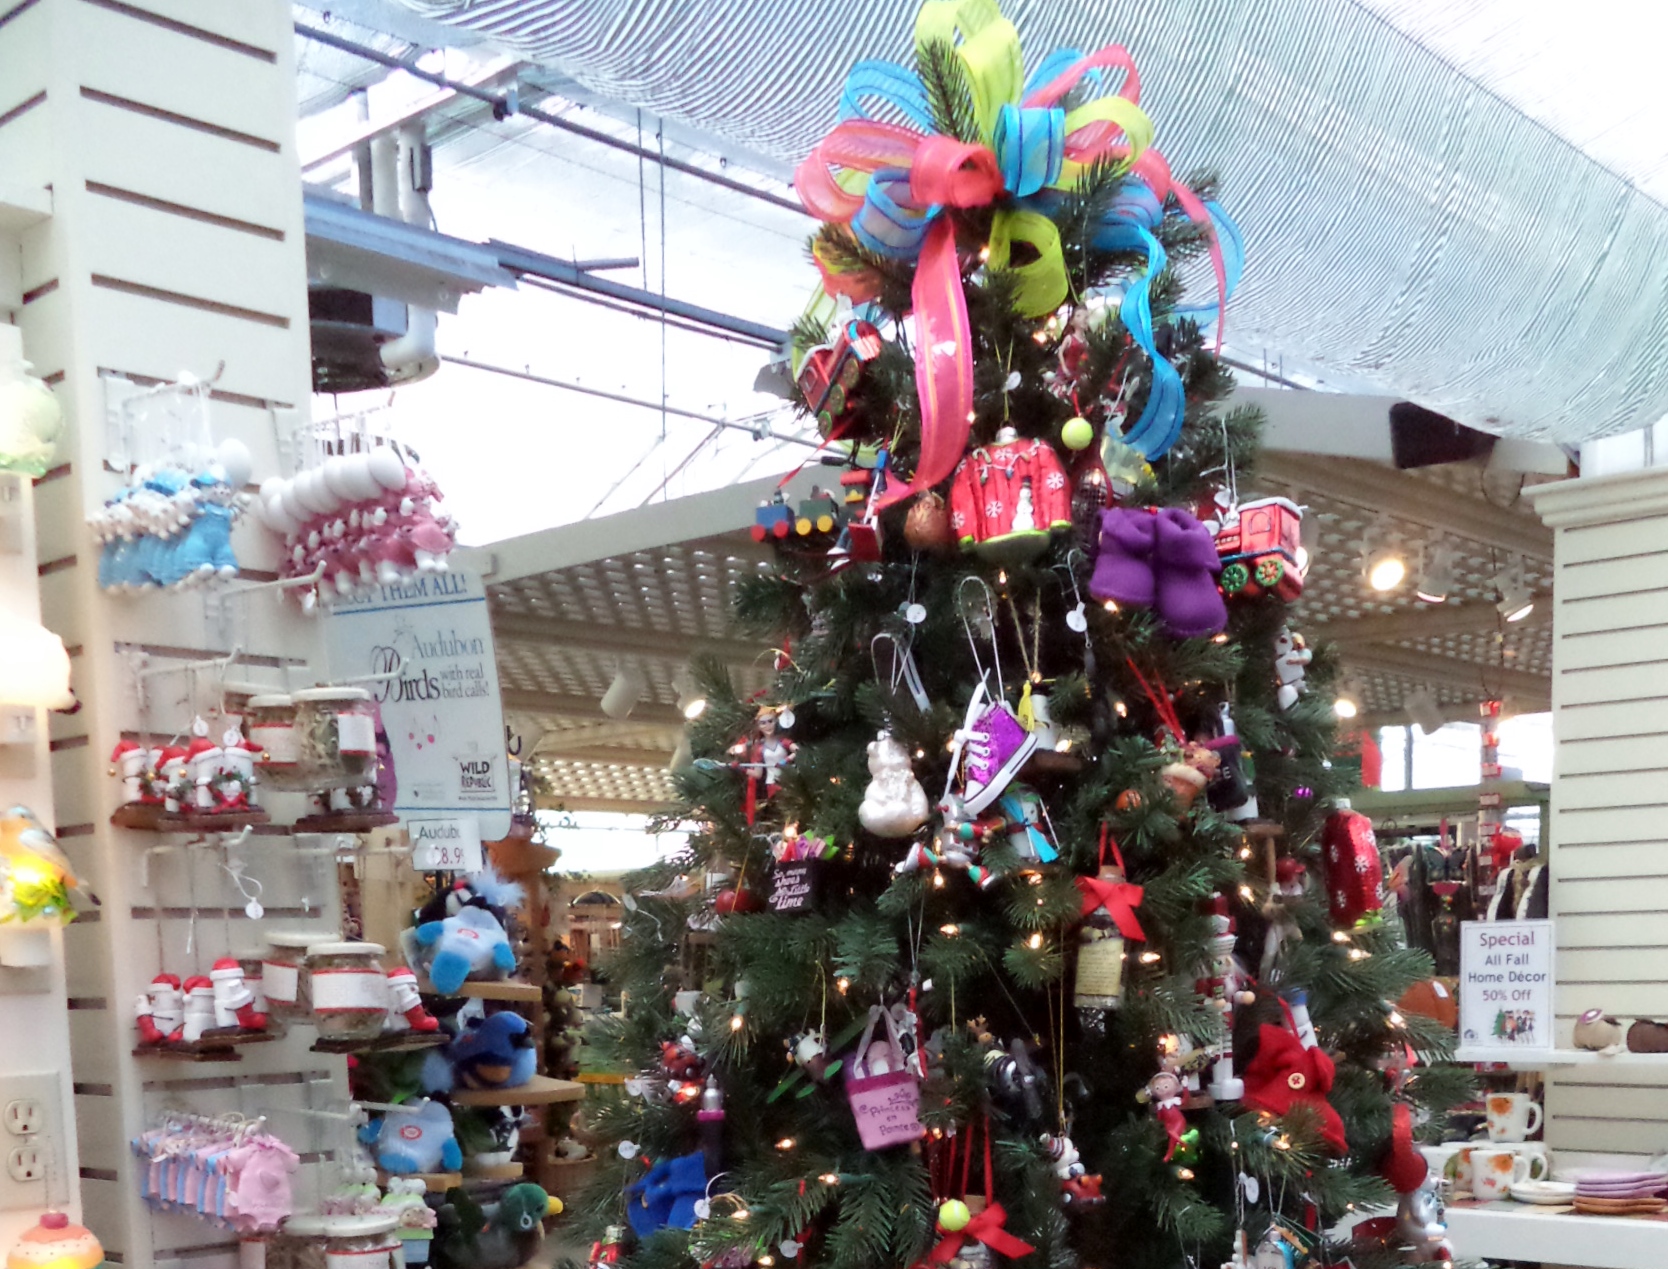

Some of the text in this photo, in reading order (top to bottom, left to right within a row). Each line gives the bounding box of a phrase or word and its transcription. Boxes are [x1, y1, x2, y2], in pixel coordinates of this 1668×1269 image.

[382, 577, 428, 600] THEM
[433, 574, 467, 596] ALL!
[412, 630, 484, 659] Audubon
[370, 645, 441, 704] Birds
[439, 663, 485, 680] with real
[441, 681, 490, 698] bird calls!
[460, 761, 490, 774] WILD
[1480, 931, 1535, 949] Special
[1485, 954, 1529, 966] All Fall
[1468, 971, 1546, 983] Home Décor
[1482, 989, 1532, 1001] 50% Off
